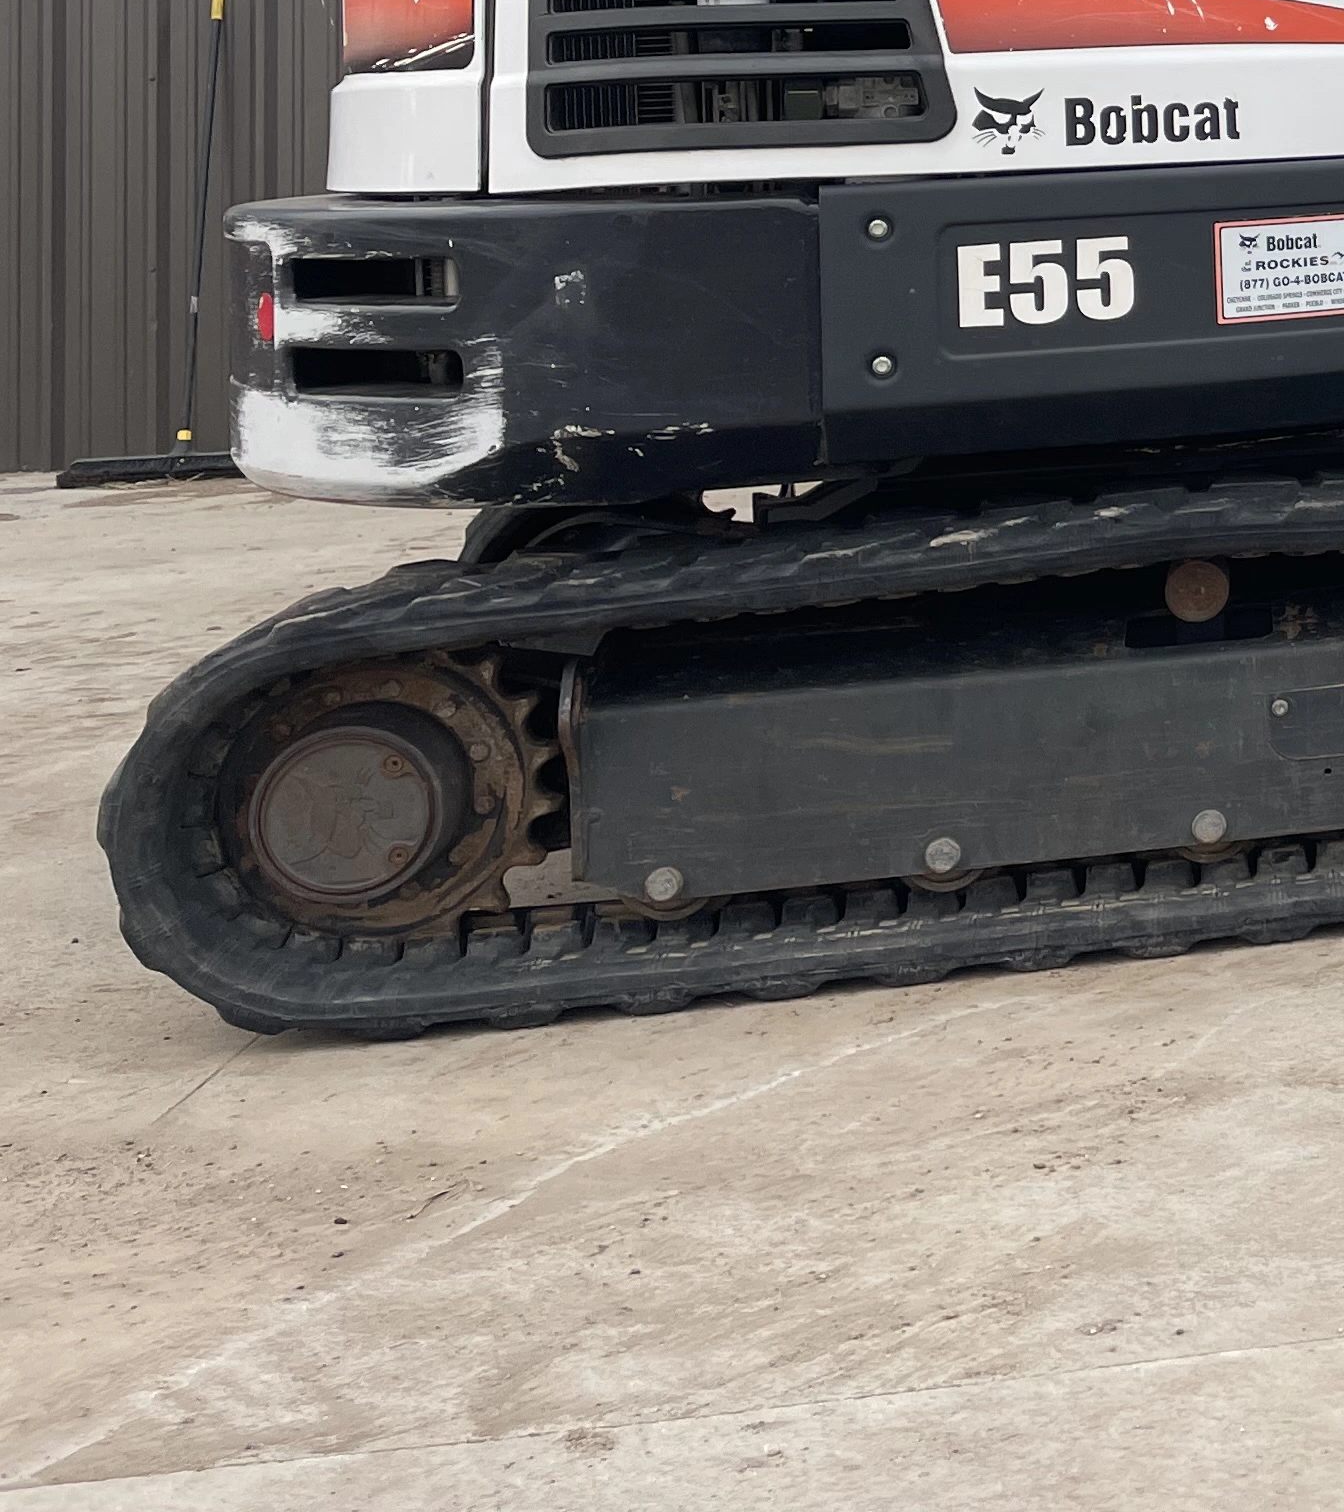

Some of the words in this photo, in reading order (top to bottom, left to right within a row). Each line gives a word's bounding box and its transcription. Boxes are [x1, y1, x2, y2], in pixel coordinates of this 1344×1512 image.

[1064, 94, 1240, 146] Bobcat
[1266, 233, 1319, 252] Bobcat
[1255, 255, 1330, 271] ROCKIES
[957, 236, 1135, 328] E55
[1239, 278, 1270, 291] (877)
